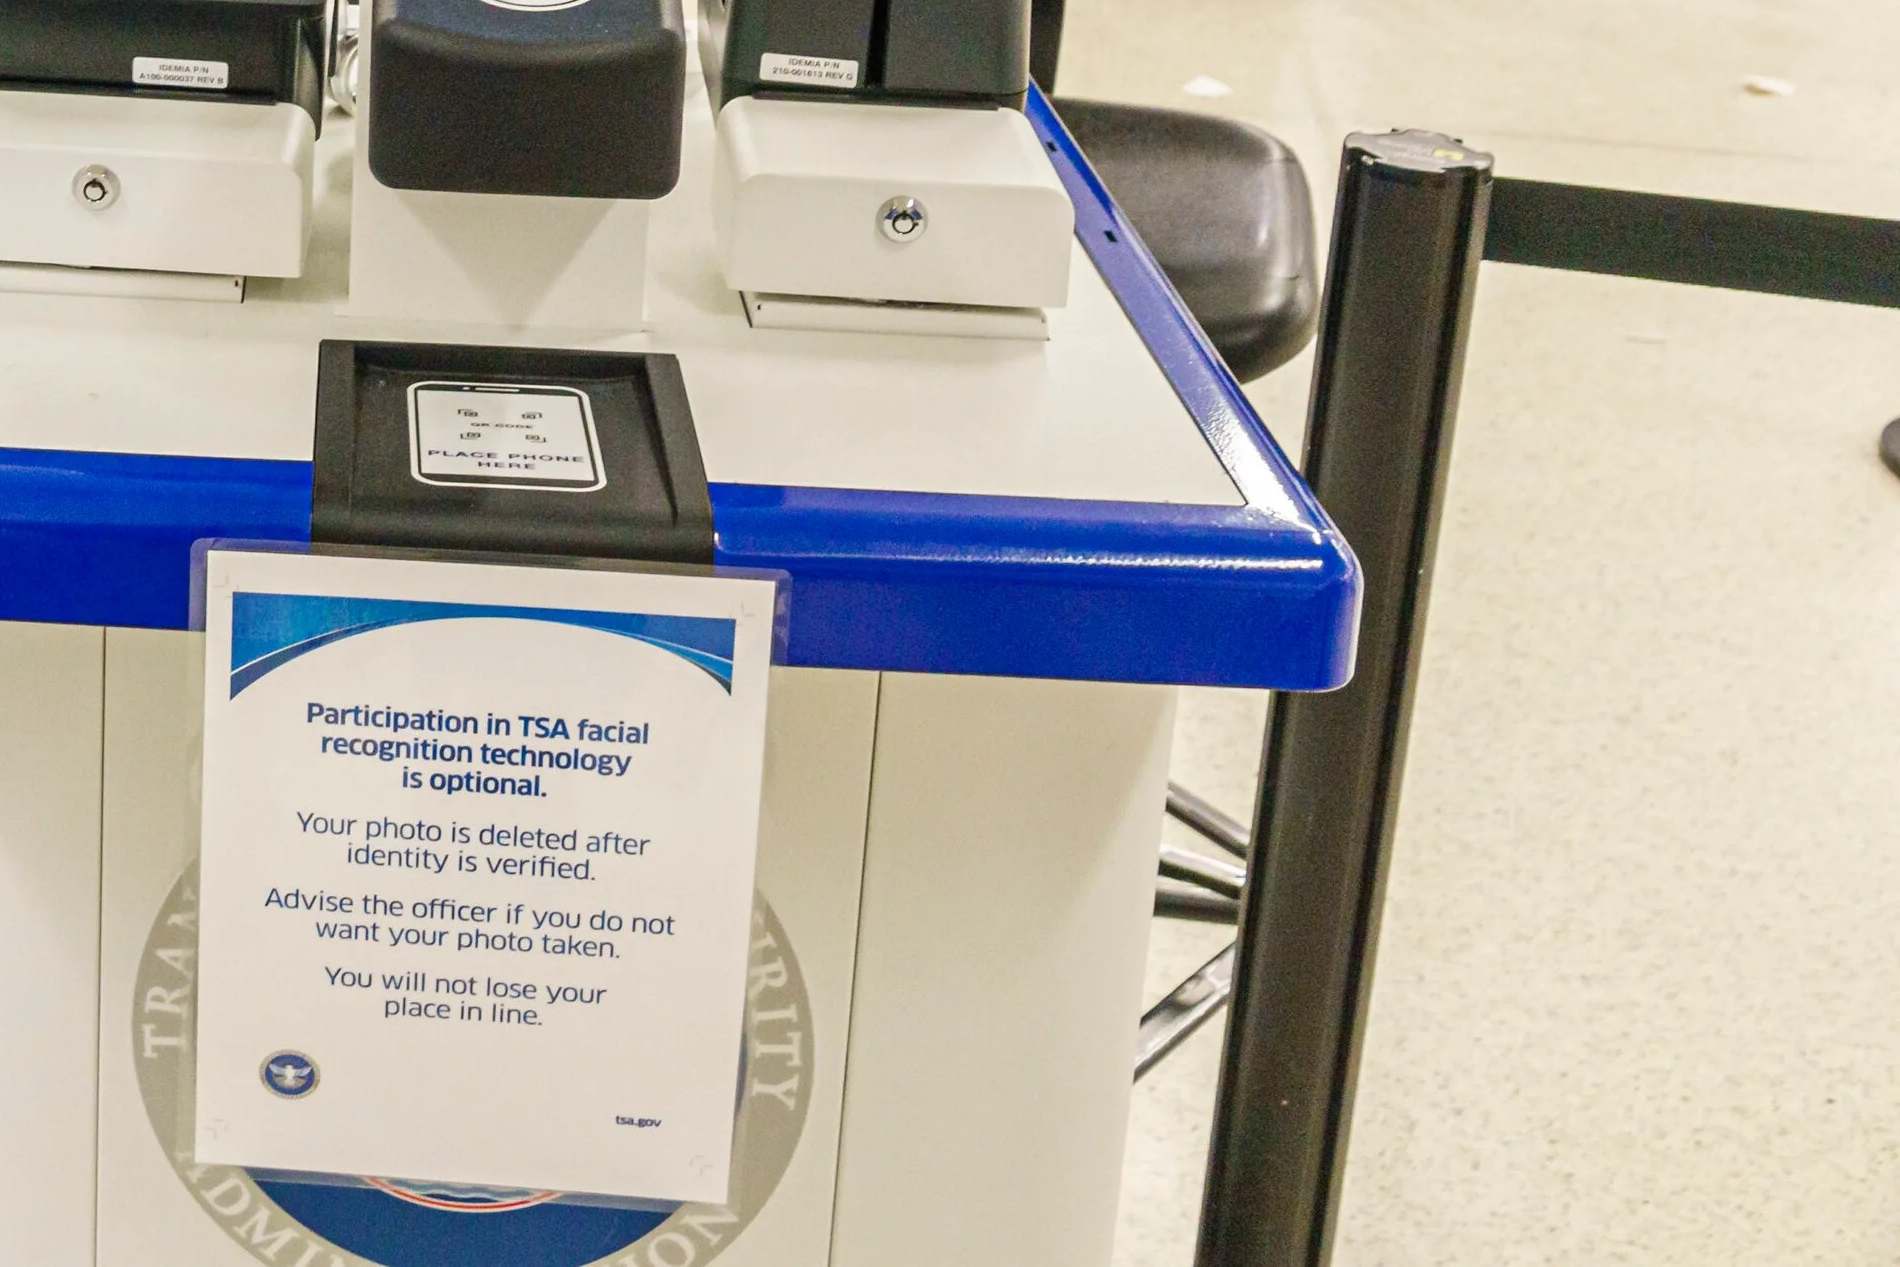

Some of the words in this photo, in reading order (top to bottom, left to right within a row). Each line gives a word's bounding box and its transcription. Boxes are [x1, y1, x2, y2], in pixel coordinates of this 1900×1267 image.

[159, 65, 190, 73] IDEMIA
[788, 58, 820, 67] IDEMIA
[428, 450, 498, 459] PLACE
[508, 454, 585, 462] PHONE
[477, 461, 536, 470] HERE
[307, 702, 478, 734] Participation
[487, 712, 511, 736] in
[518, 715, 570, 740] TSA
[577, 718, 649, 744] facial
[321, 736, 473, 763] recognition
[480, 743, 632, 777] technology
[402, 766, 423, 789] is
[429, 770, 547, 797] optional.
[297, 811, 358, 835] Your
[366, 816, 442, 842] photo
[452, 821, 471, 844] is
[479, 824, 577, 851] deleted
[586, 831, 651, 855] after
[348, 842, 449, 874] identity
[458, 850, 477, 872] is
[486, 855, 595, 881] verified.
[264, 888, 354, 913] Advise
[362, 894, 404, 917] the
[412, 898, 498, 923] officer
[507, 903, 525, 925] if
[532, 910, 581, 930] you
[589, 910, 623, 932] do
[632, 916, 675, 936] not
[316, 922, 380, 942] want
[388, 927, 449, 947] your
[457, 928, 533, 952] photo
[541, 934, 620, 958] taken.
[325, 966, 372, 988] You
[382, 971, 426, 992] will
[435, 977, 478, 996] not
[486, 977, 537, 1000] lose
[546, 985, 607, 1005] your
[385, 997, 451, 1019] place
[460, 1001, 482, 1021] in
[492, 1003, 542, 1026] line.
[616, 1115, 662, 1128] tsa.gov
